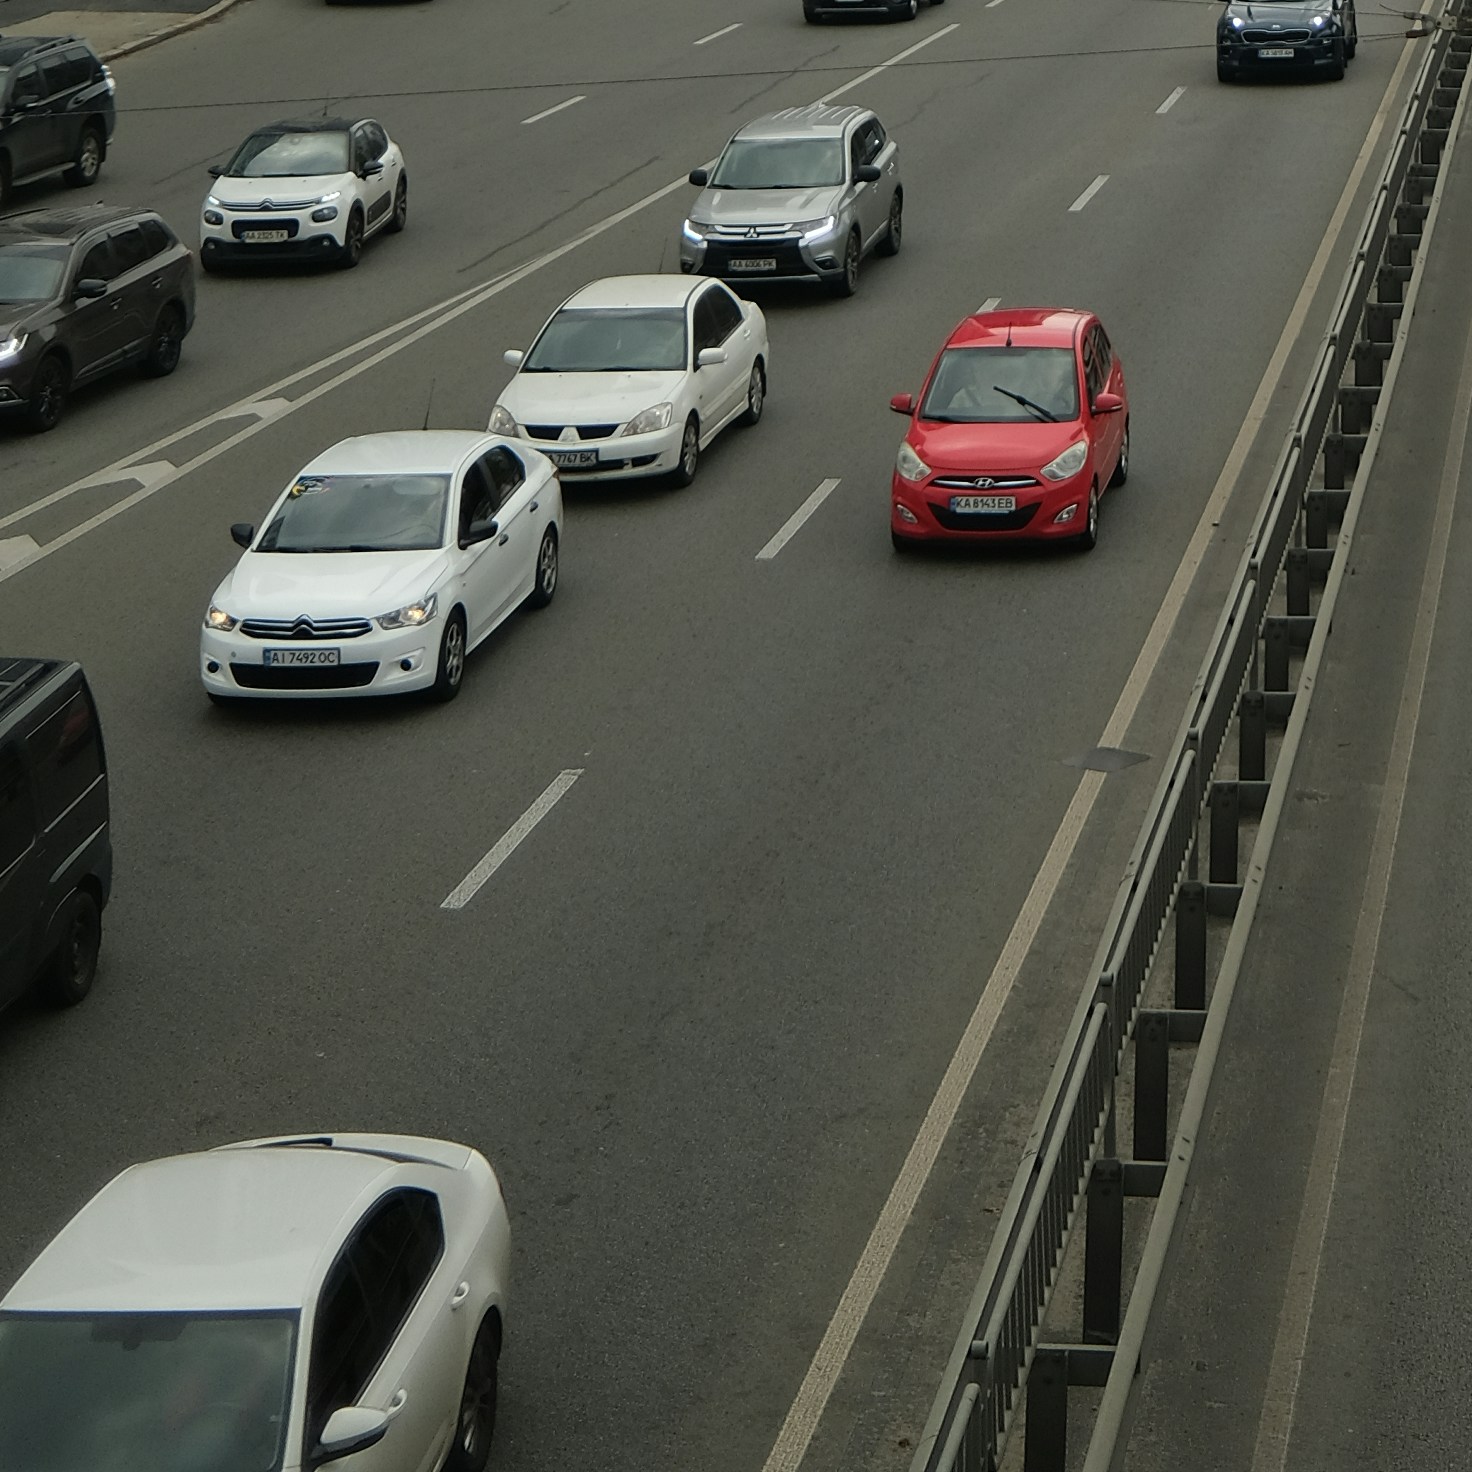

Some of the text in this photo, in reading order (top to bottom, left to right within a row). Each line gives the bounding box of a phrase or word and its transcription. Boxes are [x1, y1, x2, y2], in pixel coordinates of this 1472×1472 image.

[556, 453, 578, 463] 7767
[580, 452, 594, 462] BK
[956, 498, 1013, 508] KA 8143 EB
[272, 652, 335, 663] AI 7492 OC
